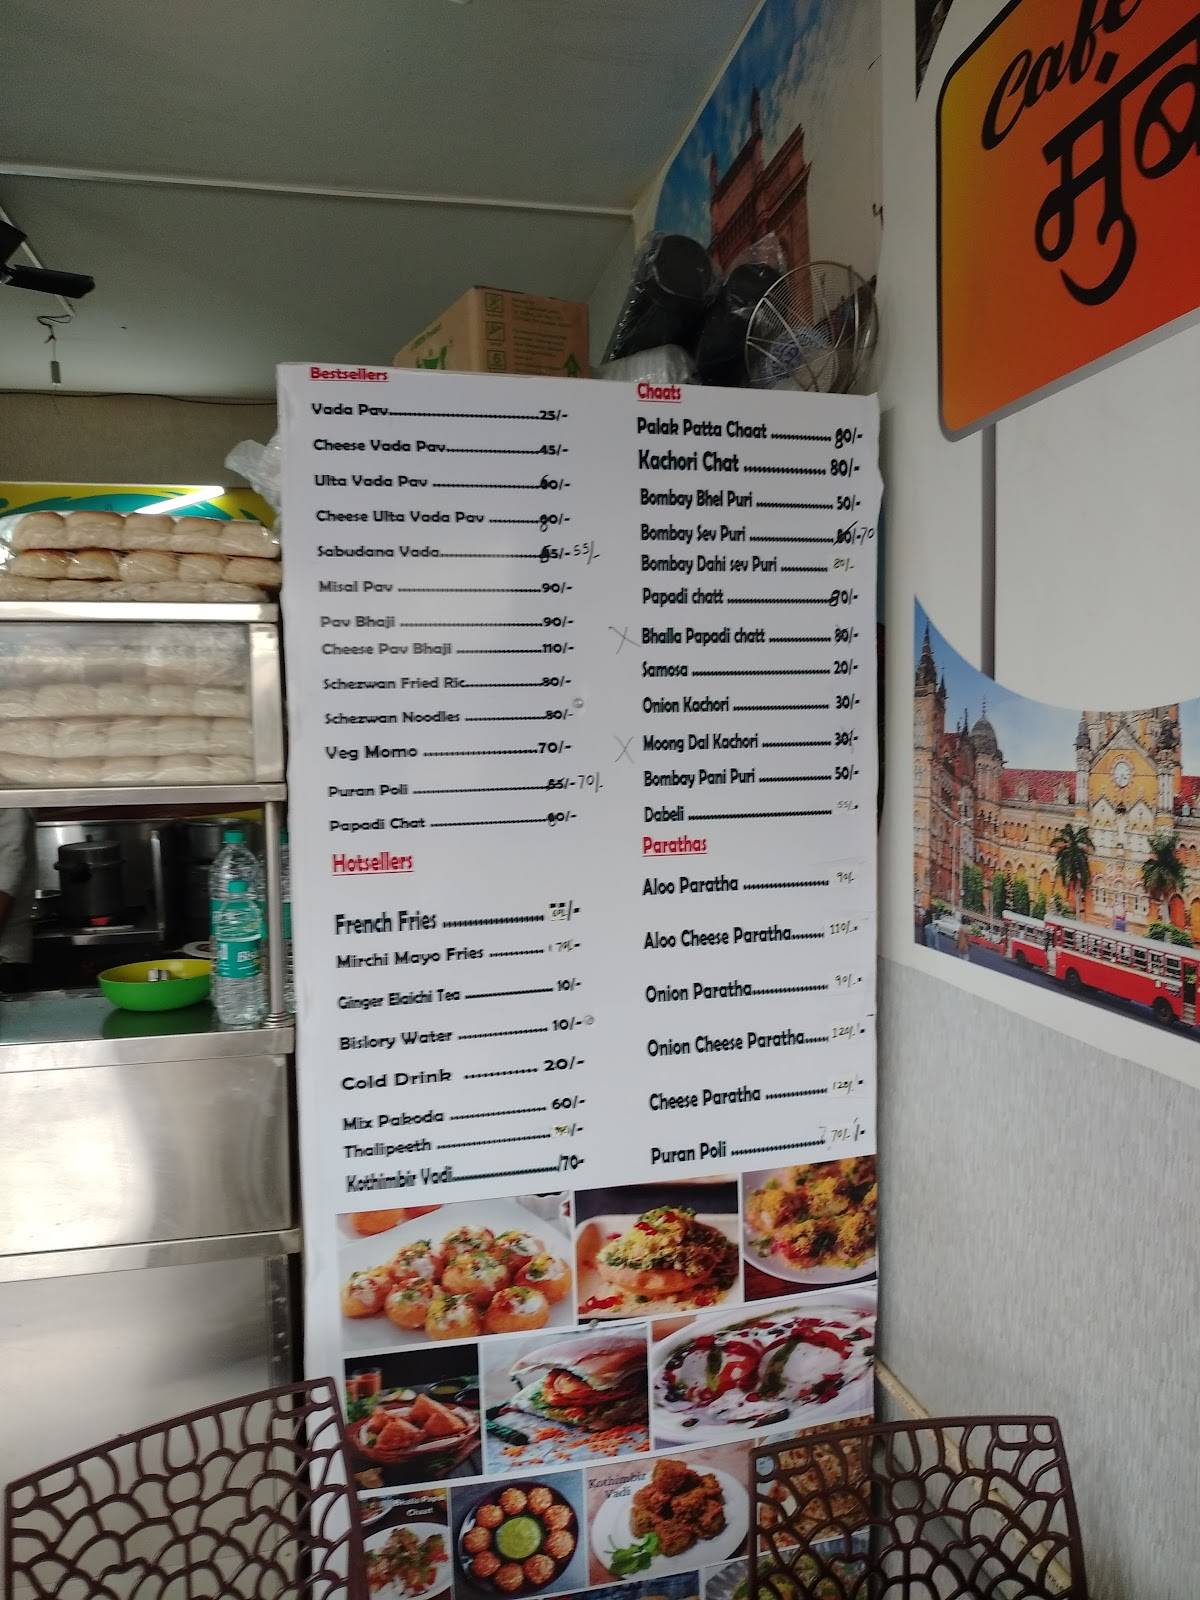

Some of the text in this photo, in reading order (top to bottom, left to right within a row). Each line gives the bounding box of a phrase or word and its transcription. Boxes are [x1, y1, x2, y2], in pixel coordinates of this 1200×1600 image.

[310, 367, 388, 381] Bestsellers
[636, 383, 681, 400] Chaats
[312, 403, 568, 421] Vada Pav 25/-
[637, 416, 680, 436] Palak
[683, 419, 722, 437] Patta
[726, 420, 767, 439] Chaat
[313, 439, 568, 456] Cheese Vada Pav 45/-
[638, 449, 859, 477] Kachori Chat 80/-
[314, 474, 347, 487] Ulta
[352, 475, 392, 487] Vada
[398, 475, 427, 488] Pav
[640, 488, 860, 511] Bombay Bhel Puri 50/-
[316, 510, 368, 523] Cheese
[373, 510, 405, 523] Ulta
[410, 511, 450, 523] Vada
[456, 511, 484, 524] Pav
[640, 523, 693, 544] Bombay
[697, 524, 716, 542] Sev
[720, 524, 746, 542] Puri
[317, 546, 394, 557] Sabudana
[399, 546, 440, 558] Vada
[641, 554, 693, 575] Bombay
[697, 555, 726, 571] Dahi
[752, 555, 777, 572] Puri
[319, 580, 573, 594] Misal Pav 90/-
[642, 587, 688, 607] Papadi
[320, 615, 573, 629] Pav Bhaji 90/-
[642, 627, 682, 644] Bhalla
[686, 628, 730, 646] Papadi
[734, 627, 766, 643] chatt
[321, 642, 574, 656] Cheese Pav Bhaji 110/-
[642, 659, 858, 677] Samosa 20/-
[323, 677, 396, 690] Schezwan
[401, 677, 439, 690] Fried
[642, 693, 860, 713] Onion Kachori 30/-
[325, 712, 397, 725] Schezwan
[403, 711, 460, 724] Noodles
[325, 741, 572, 761] Veg Momo 70/-
[643, 735, 684, 752] Moong
[688, 733, 709, 750] Dal
[713, 733, 759, 750] Kachori
[644, 764, 859, 788] Bombay Pani Puri 50/-
[328, 786, 375, 797] Puran
[380, 784, 408, 796] Poli
[329, 819, 385, 832] Papadi
[391, 817, 426, 830] Chat
[644, 806, 684, 823] Dabeli
[642, 836, 708, 854] Parathas
[332, 851, 413, 873] Hotsellers
[642, 877, 675, 896] Aloo
[680, 874, 739, 894] Paratha
[335, 912, 392, 935] French
[399, 910, 436, 931] Fries
[644, 931, 676, 949] Aloo
[681, 929, 729, 947] Cheese
[733, 925, 792, 943] Paratha
[336, 953, 389, 968] Mirchi
[395, 950, 440, 965] Mayo
[446, 948, 484, 963] Fries
[338, 996, 384, 1010] Ginger
[436, 989, 460, 1002] Tea
[556, 978, 582, 992] 10/-
[645, 985, 688, 1003] Onion
[693, 980, 752, 999] Paratha
[339, 1019, 582, 1051] Bislory Water 10/-
[648, 1038, 690, 1056] Onion
[695, 1034, 743, 1053] Cheese
[747, 1029, 805, 1049] Paratha
[342, 1057, 585, 1091] Cold Drink 20/-
[649, 1094, 698, 1111] Cheese
[703, 1085, 761, 1105] Paratha
[343, 1096, 586, 1130] Mix Pakoda 60/-
[344, 1138, 431, 1158] Thalipeeth
[651, 1147, 696, 1165] Puran
[700, 1141, 726, 1159] Poli
[346, 1173, 417, 1193] Kothimbir
[421, 1166, 453, 1185] Vadi
